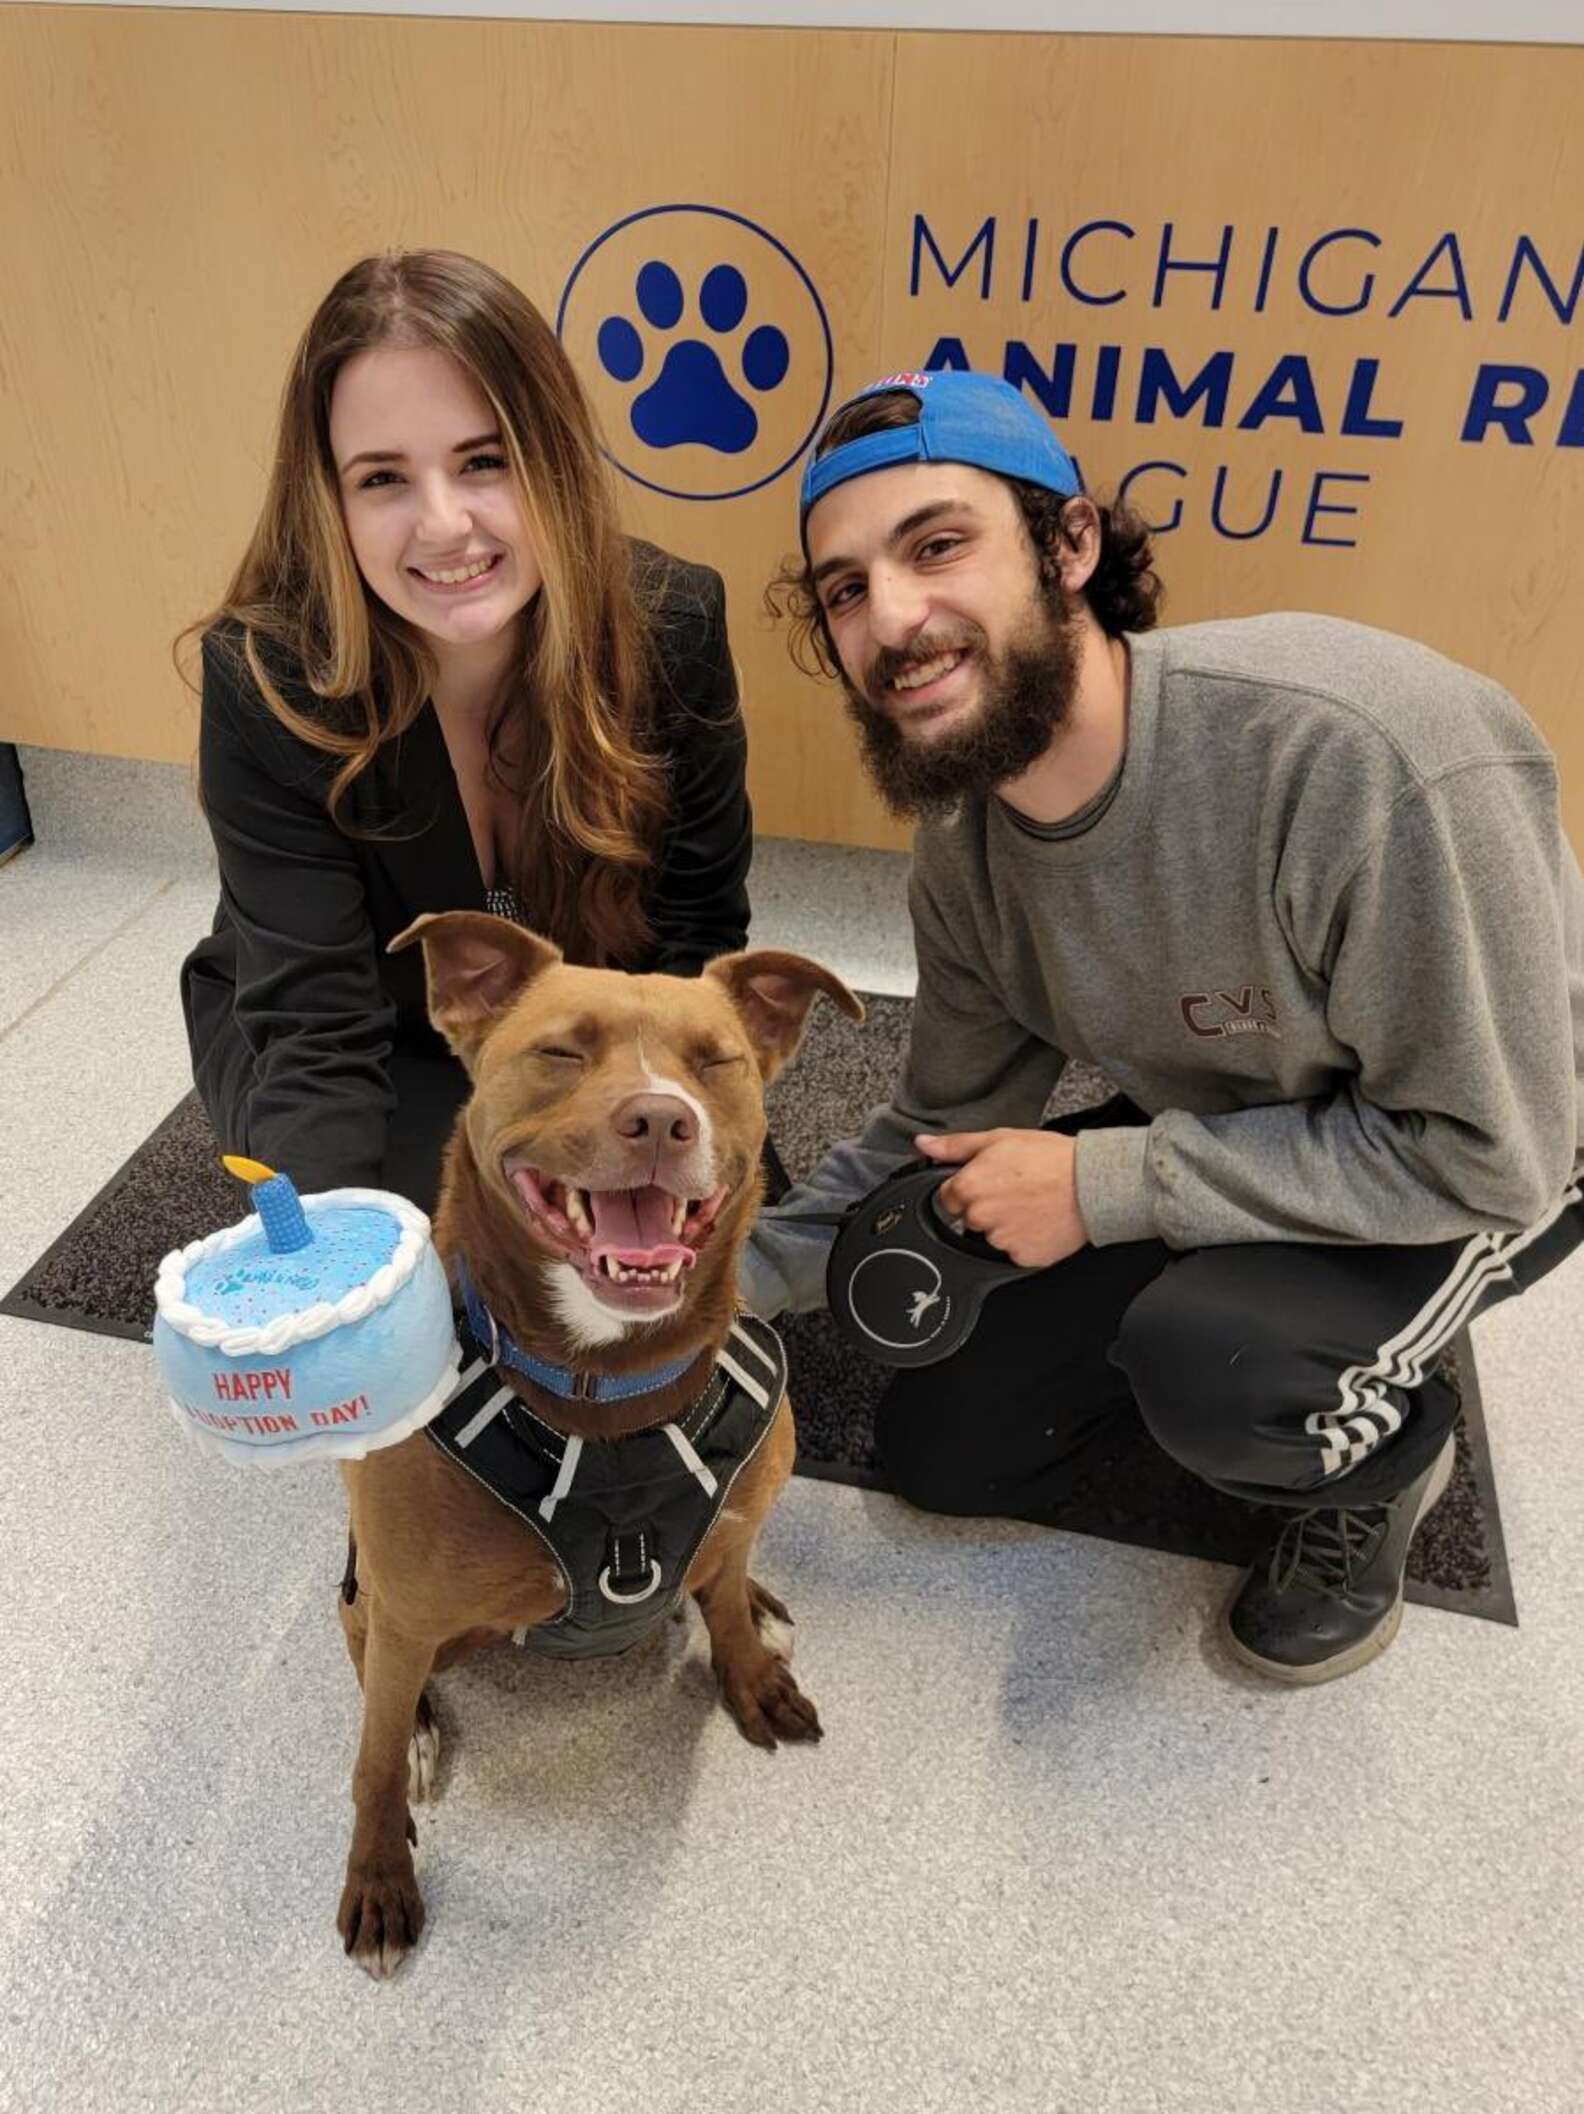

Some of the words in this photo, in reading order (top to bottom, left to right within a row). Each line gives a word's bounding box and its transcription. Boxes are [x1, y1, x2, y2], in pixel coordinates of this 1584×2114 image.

[909, 213, 1584, 324] MICHIGAN
[213, 1367, 293, 1400] HAPPY
[310, 1395, 371, 1426] DAY!
